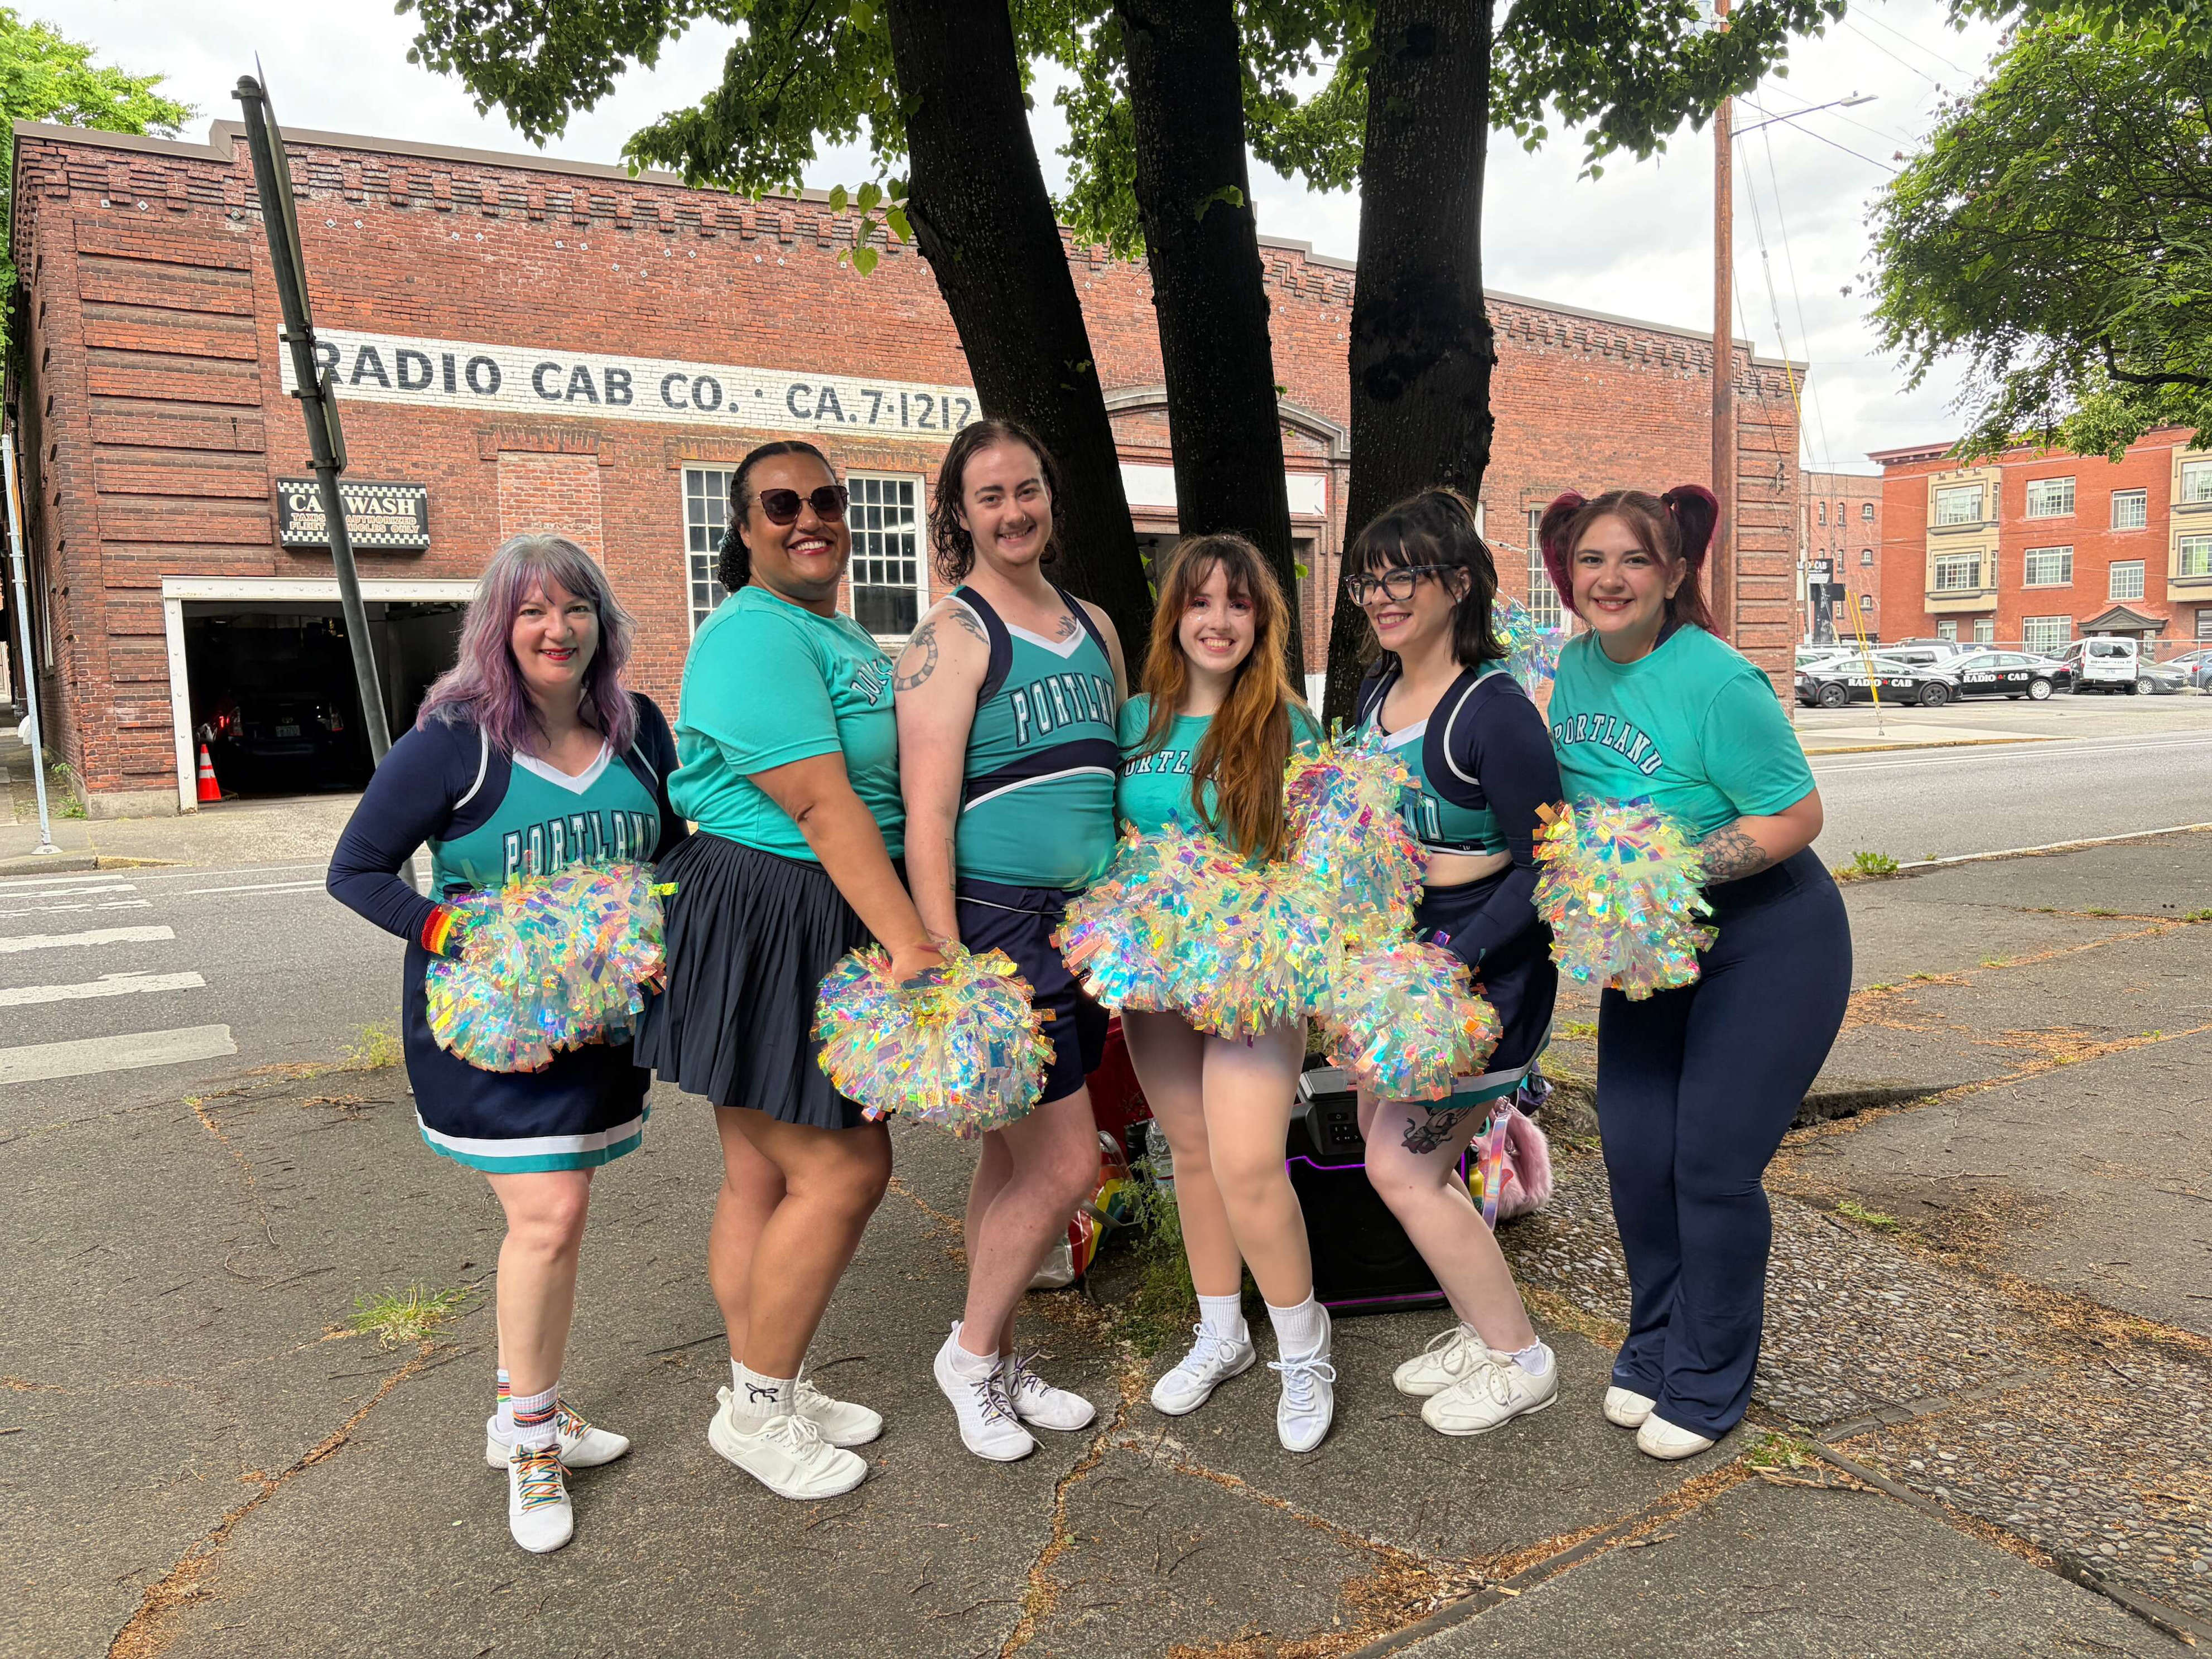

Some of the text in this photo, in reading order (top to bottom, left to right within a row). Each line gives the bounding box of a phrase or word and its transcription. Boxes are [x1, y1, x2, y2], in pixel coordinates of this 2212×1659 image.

[315, 340, 502, 395] RADIO
[531, 361, 634, 406] CAB
[660, 373, 739, 413] CO.
[289, 494, 417, 515] CA WASH
[290, 521, 420, 533] FLEET HICLES ONLY
[291, 513, 417, 525] TAXIS AUTHORIZED
[1815, 560, 1827, 570] CAB
[1848, 678, 1882, 687] RADIO
[1891, 678, 1912, 687] CAB
[1963, 673, 2028, 683] RADIO CAB
[1009, 672, 1116, 747] PORTLAN
[1553, 713, 1663, 776] PORTLAND
[502, 810, 656, 885] PORTLAND
